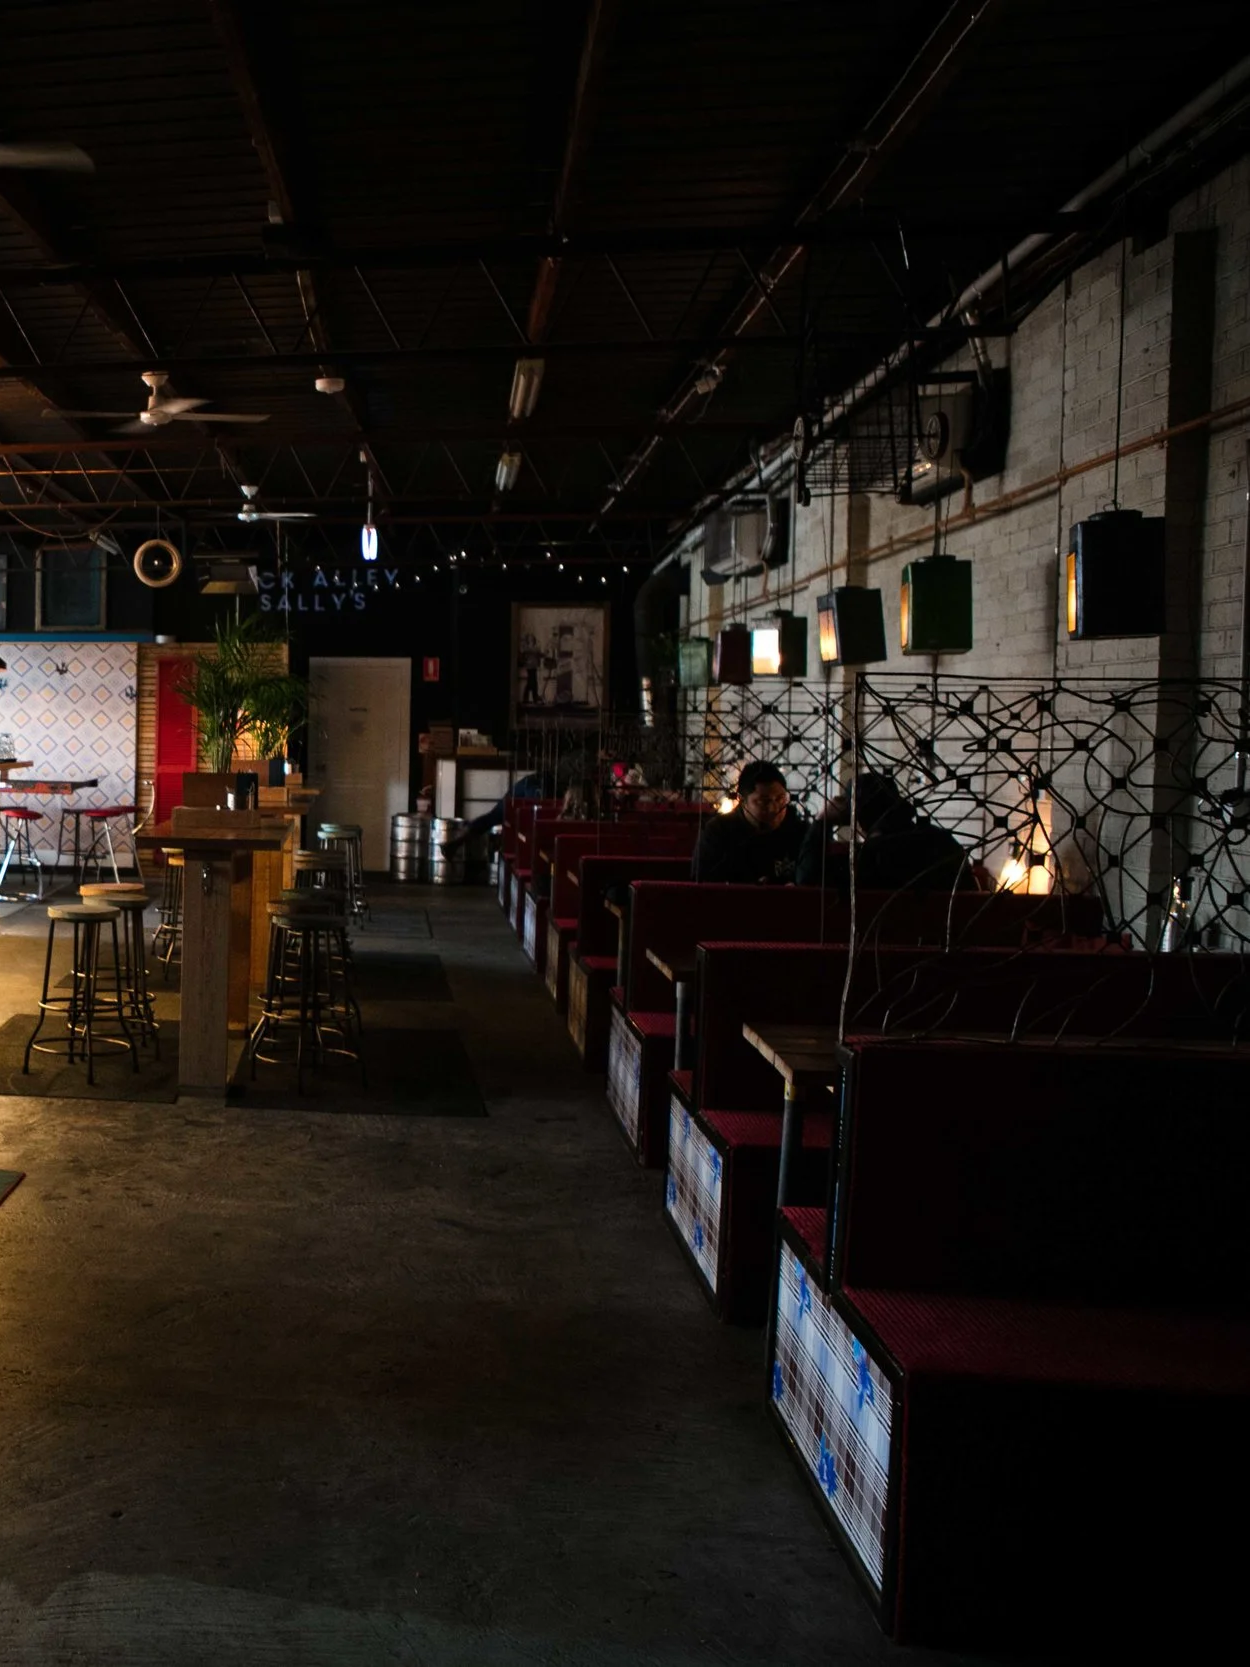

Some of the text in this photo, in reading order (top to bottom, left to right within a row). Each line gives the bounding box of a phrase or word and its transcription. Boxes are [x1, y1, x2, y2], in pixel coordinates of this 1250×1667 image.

[258, 568, 399, 590] CK ALLEY
[259, 589, 367, 612] SALLY'S
